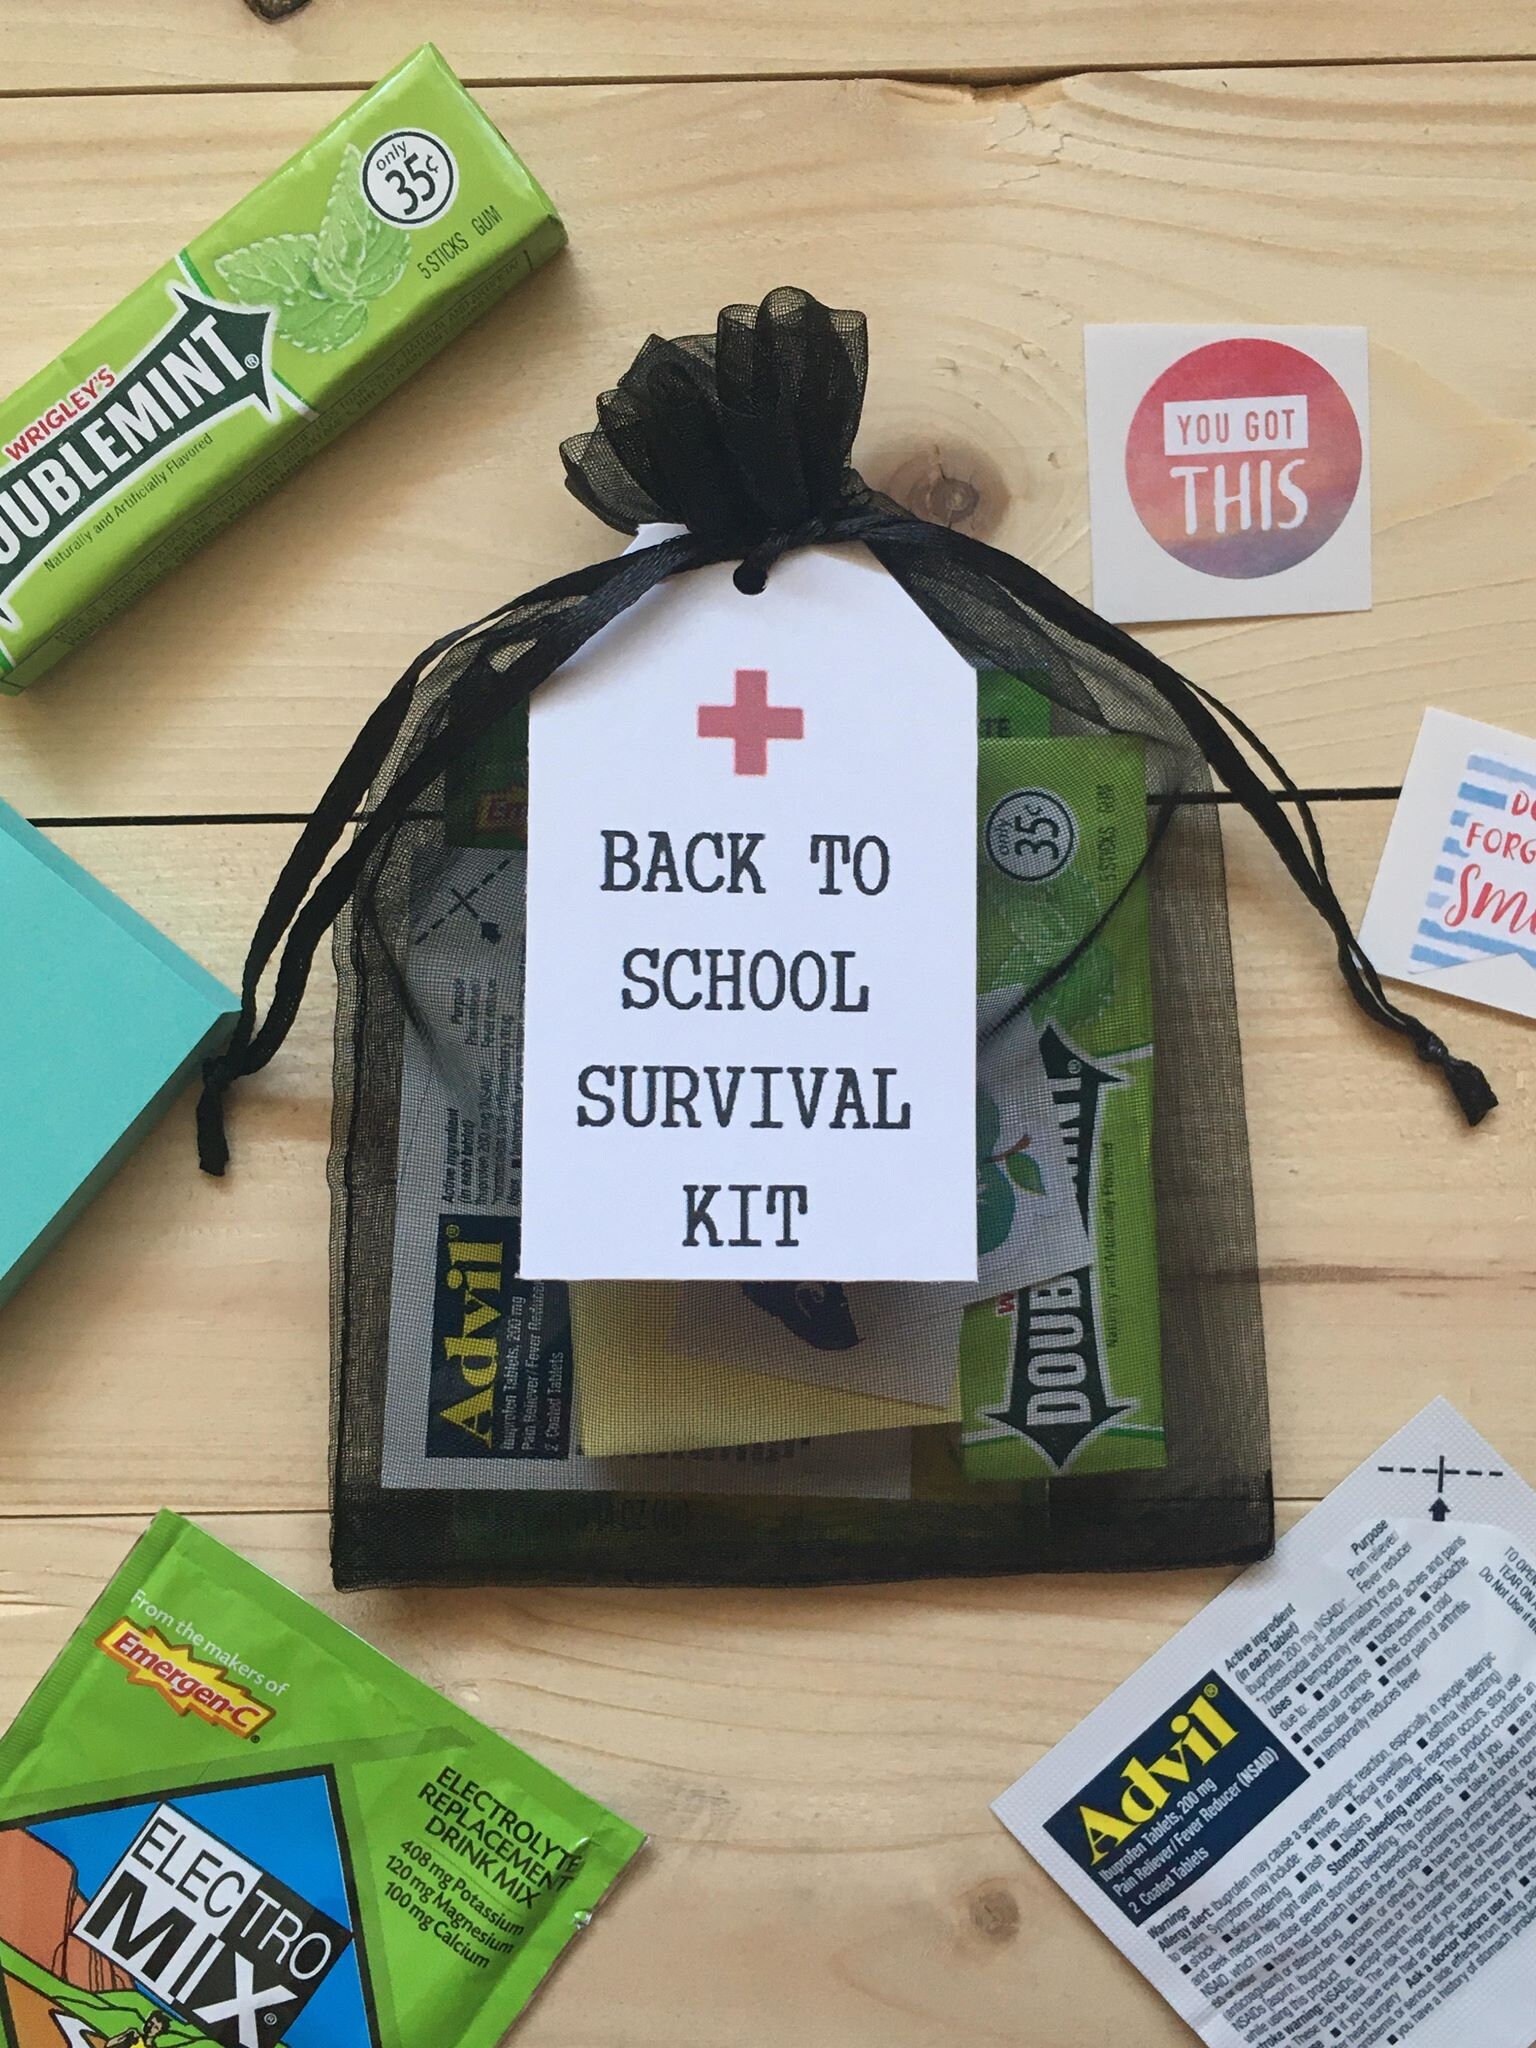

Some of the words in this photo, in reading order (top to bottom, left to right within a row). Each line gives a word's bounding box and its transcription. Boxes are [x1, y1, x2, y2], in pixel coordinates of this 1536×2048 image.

[375, 141, 408, 172] only
[416, 261, 431, 279] 5
[424, 231, 469, 272] STICKS
[470, 204, 502, 236] GUM
[4, 366, 117, 462] WRIGLEY'S
[1177, 409, 1229, 446] YOU
[1246, 407, 1296, 443] GOT
[43, 530, 93, 572] Naturally
[91, 511, 114, 534] and
[113, 471, 167, 517] Artificially
[165, 432, 213, 474] Flavored
[1170, 458, 1309, 535] THIS
[600, 830, 766, 894] BACK
[810, 834, 890, 896] TO
[621, 948, 869, 1012] SCHOOL
[577, 1064, 911, 1130] SURVIVAL
[683, 1184, 808, 1248] KIT
[1026, 1275, 1091, 1426] DOUB
[1346, 1559, 1369, 1580] Pain
[1350, 1519, 1389, 1556] Purpose
[1355, 1568, 1382, 1593] Fever
[1379, 1541, 1412, 1573] reducer
[1498, 1562, 1522, 1590] TEAR
[1504, 1546, 1519, 1562] TO
[1267, 1695, 1292, 1719] Uses
[1303, 1642, 1351, 1686] temporarily
[1348, 1617, 1379, 1646] relieves
[1378, 1593, 1404, 1618] minor
[1401, 1570, 1428, 1597] aches
[1424, 1554, 1444, 1574] and
[1440, 1535, 1466, 1561] pains
[1375, 1577, 1400, 1600] drug
[1478, 1565, 1494, 1583] Do
[1491, 1579, 1509, 1599] Not
[1506, 1594, 1524, 1615] Use
[130, 1588, 175, 1627] From
[174, 1619, 205, 1646] the
[202, 1639, 265, 1684] makers
[264, 1678, 290, 1697] of
[1223, 1642, 1253, 1671] Active
[1250, 1602, 1296, 1647] ingredient
[1234, 1667, 1250, 1684] (in
[1247, 1648, 1271, 1671] each
[1268, 1621, 1299, 1652] tablet)
[1244, 1657, 1285, 1695] Ibuprofen
[1281, 1641, 1302, 1662] 200
[1299, 1629, 1318, 1646] mg
[1278, 1712, 1297, 1731] due
[1320, 1654, 1362, 1692] headache
[1373, 1605, 1416, 1644] toothache
[1427, 1555, 1468, 1594] backache
[1299, 1694, 1341, 1735] menstrual
[1338, 1668, 1372, 1700] cramps
[1382, 1642, 1400, 1658] the
[1397, 1610, 1435, 1646] common
[1431, 1591, 1452, 1613] cold
[1310, 1710, 1349, 1747] muscular
[1347, 1688, 1374, 1714] aches
[1386, 1653, 1412, 1678] minor
[1410, 1636, 1432, 1659] pain
[1427, 1626, 1440, 1640] of
[1436, 1599, 1470, 1631] arthritis
[107, 1630, 260, 1736] Emergen-C
[1321, 1716, 1370, 1760] temporarily
[1366, 1687, 1401, 1720] reduces
[1396, 1667, 1421, 1690] fever
[418, 1785, 575, 1893] REPLACEMENT
[436, 1766, 583, 1874] ELECTROLYTE
[1098, 1841, 1147, 1882] Ibuprofen
[1141, 1810, 1183, 1846] Tablets,
[1176, 1790, 1199, 1814] 200
[1196, 1777, 1217, 1797] mg
[1112, 1874, 1138, 1897] Pain
[1198, 1781, 1241, 1821] Reducer
[1236, 1745, 1279, 1787] (NSAID)
[1157, 1923, 1191, 1953] Allergy
[1209, 1874, 1251, 1912] Ibuprofen
[1248, 1859, 1270, 1879] may
[1267, 1836, 1294, 1862] cause
[1291, 1829, 1301, 1840] a
[1298, 1805, 1328, 1833] severe
[1324, 1778, 1357, 1810] allergic
[1353, 1748, 1392, 1782] reaction,
[1388, 1711, 1431, 1751] especially
[1428, 1703, 1439, 1715] in
[1436, 1678, 1467, 1708] people
[1463, 1651, 1496, 1682] allergic
[1206, 1896, 1253, 1935] Symptoms
[1249, 1881, 1271, 1901] may
[1268, 1853, 1300, 1884] include:
[1314, 1817, 1340, 1840] hives
[1352, 1780, 1378, 1806] facial
[1375, 1751, 1413, 1786] swelling
[1425, 1709, 1458, 1741] asthma
[1455, 1669, 1502, 1714] (wheezing)
[1326, 1837, 1368, 1876] Stomach
[1364, 1803, 1407, 1842] bleeding
[1403, 1769, 1445, 1808] warning:
[131, 1818, 332, 1980] ELECTRO
[384, 1854, 413, 1880] 120
[407, 1875, 435, 1904] mg
[431, 1891, 517, 1960] Magnesium
[399, 1839, 432, 1867] 408
[426, 1861, 454, 1890] mg
[450, 1877, 528, 1939] Potassium
[425, 1815, 499, 1880] DRINK
[499, 1865, 542, 1911] MIX
[1128, 1901, 1141, 1914] 2
[1138, 1873, 1175, 1906] Coated
[1170, 1846, 1209, 1880] Tablets
[383, 1881, 412, 1908] 100
[406, 1903, 434, 1931] mg
[432, 1920, 491, 1970] Calcium
[1147, 1903, 1190, 1943] Warnings
